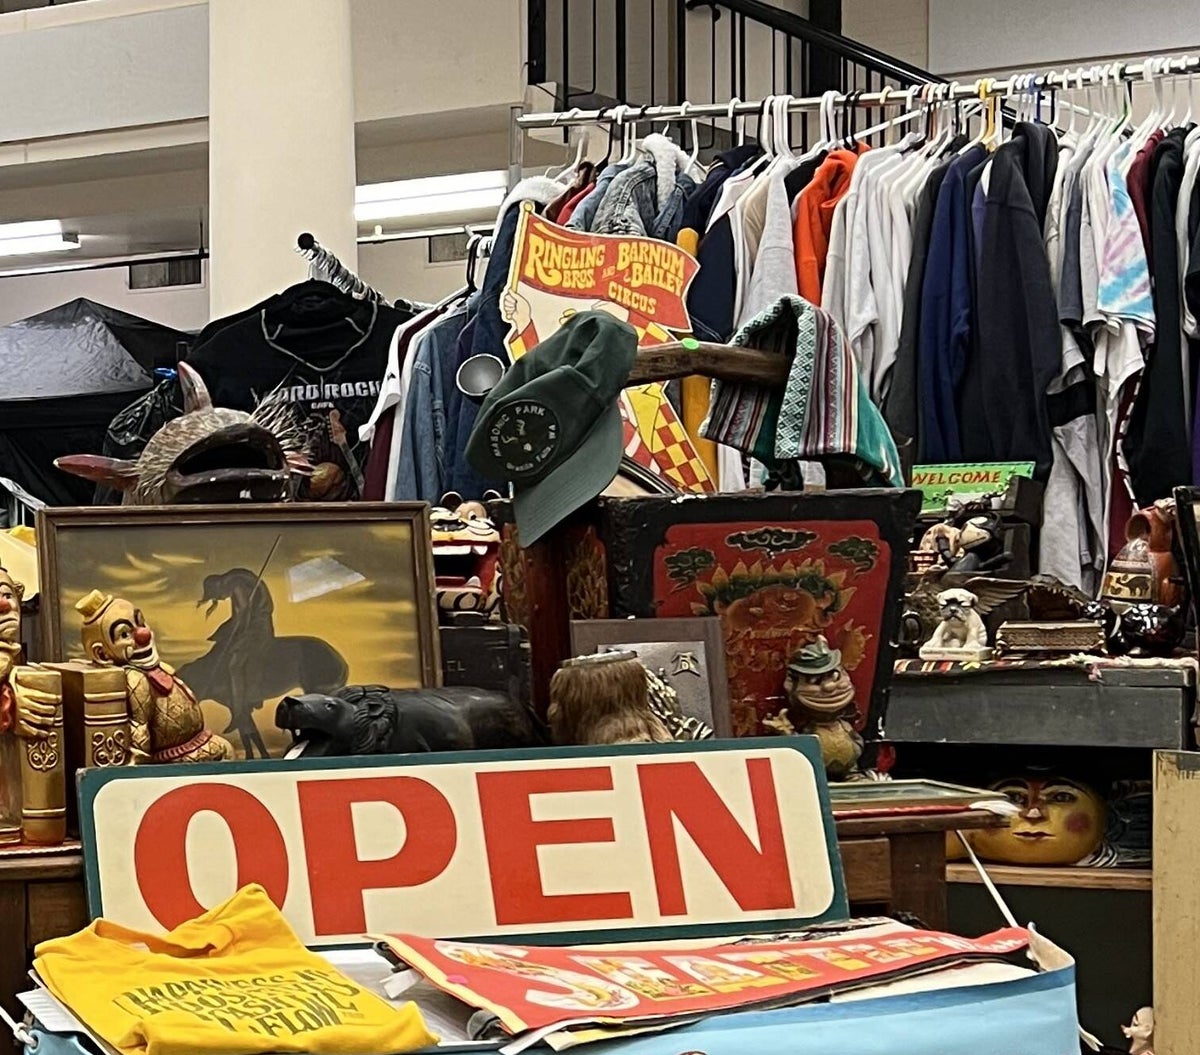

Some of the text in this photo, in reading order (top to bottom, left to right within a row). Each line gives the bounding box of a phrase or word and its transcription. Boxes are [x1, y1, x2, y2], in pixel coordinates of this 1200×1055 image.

[524, 233, 606, 286] RINGLING
[617, 242, 686, 279] BARNUM
[562, 269, 596, 289] BROS.
[631, 262, 684, 298] BAILEY
[608, 281, 658, 315] CIRCUS
[490, 405, 546, 457] MASONIC PARK
[912, 470, 1002, 485] WELCOME
[134, 757, 796, 937] OPEN
